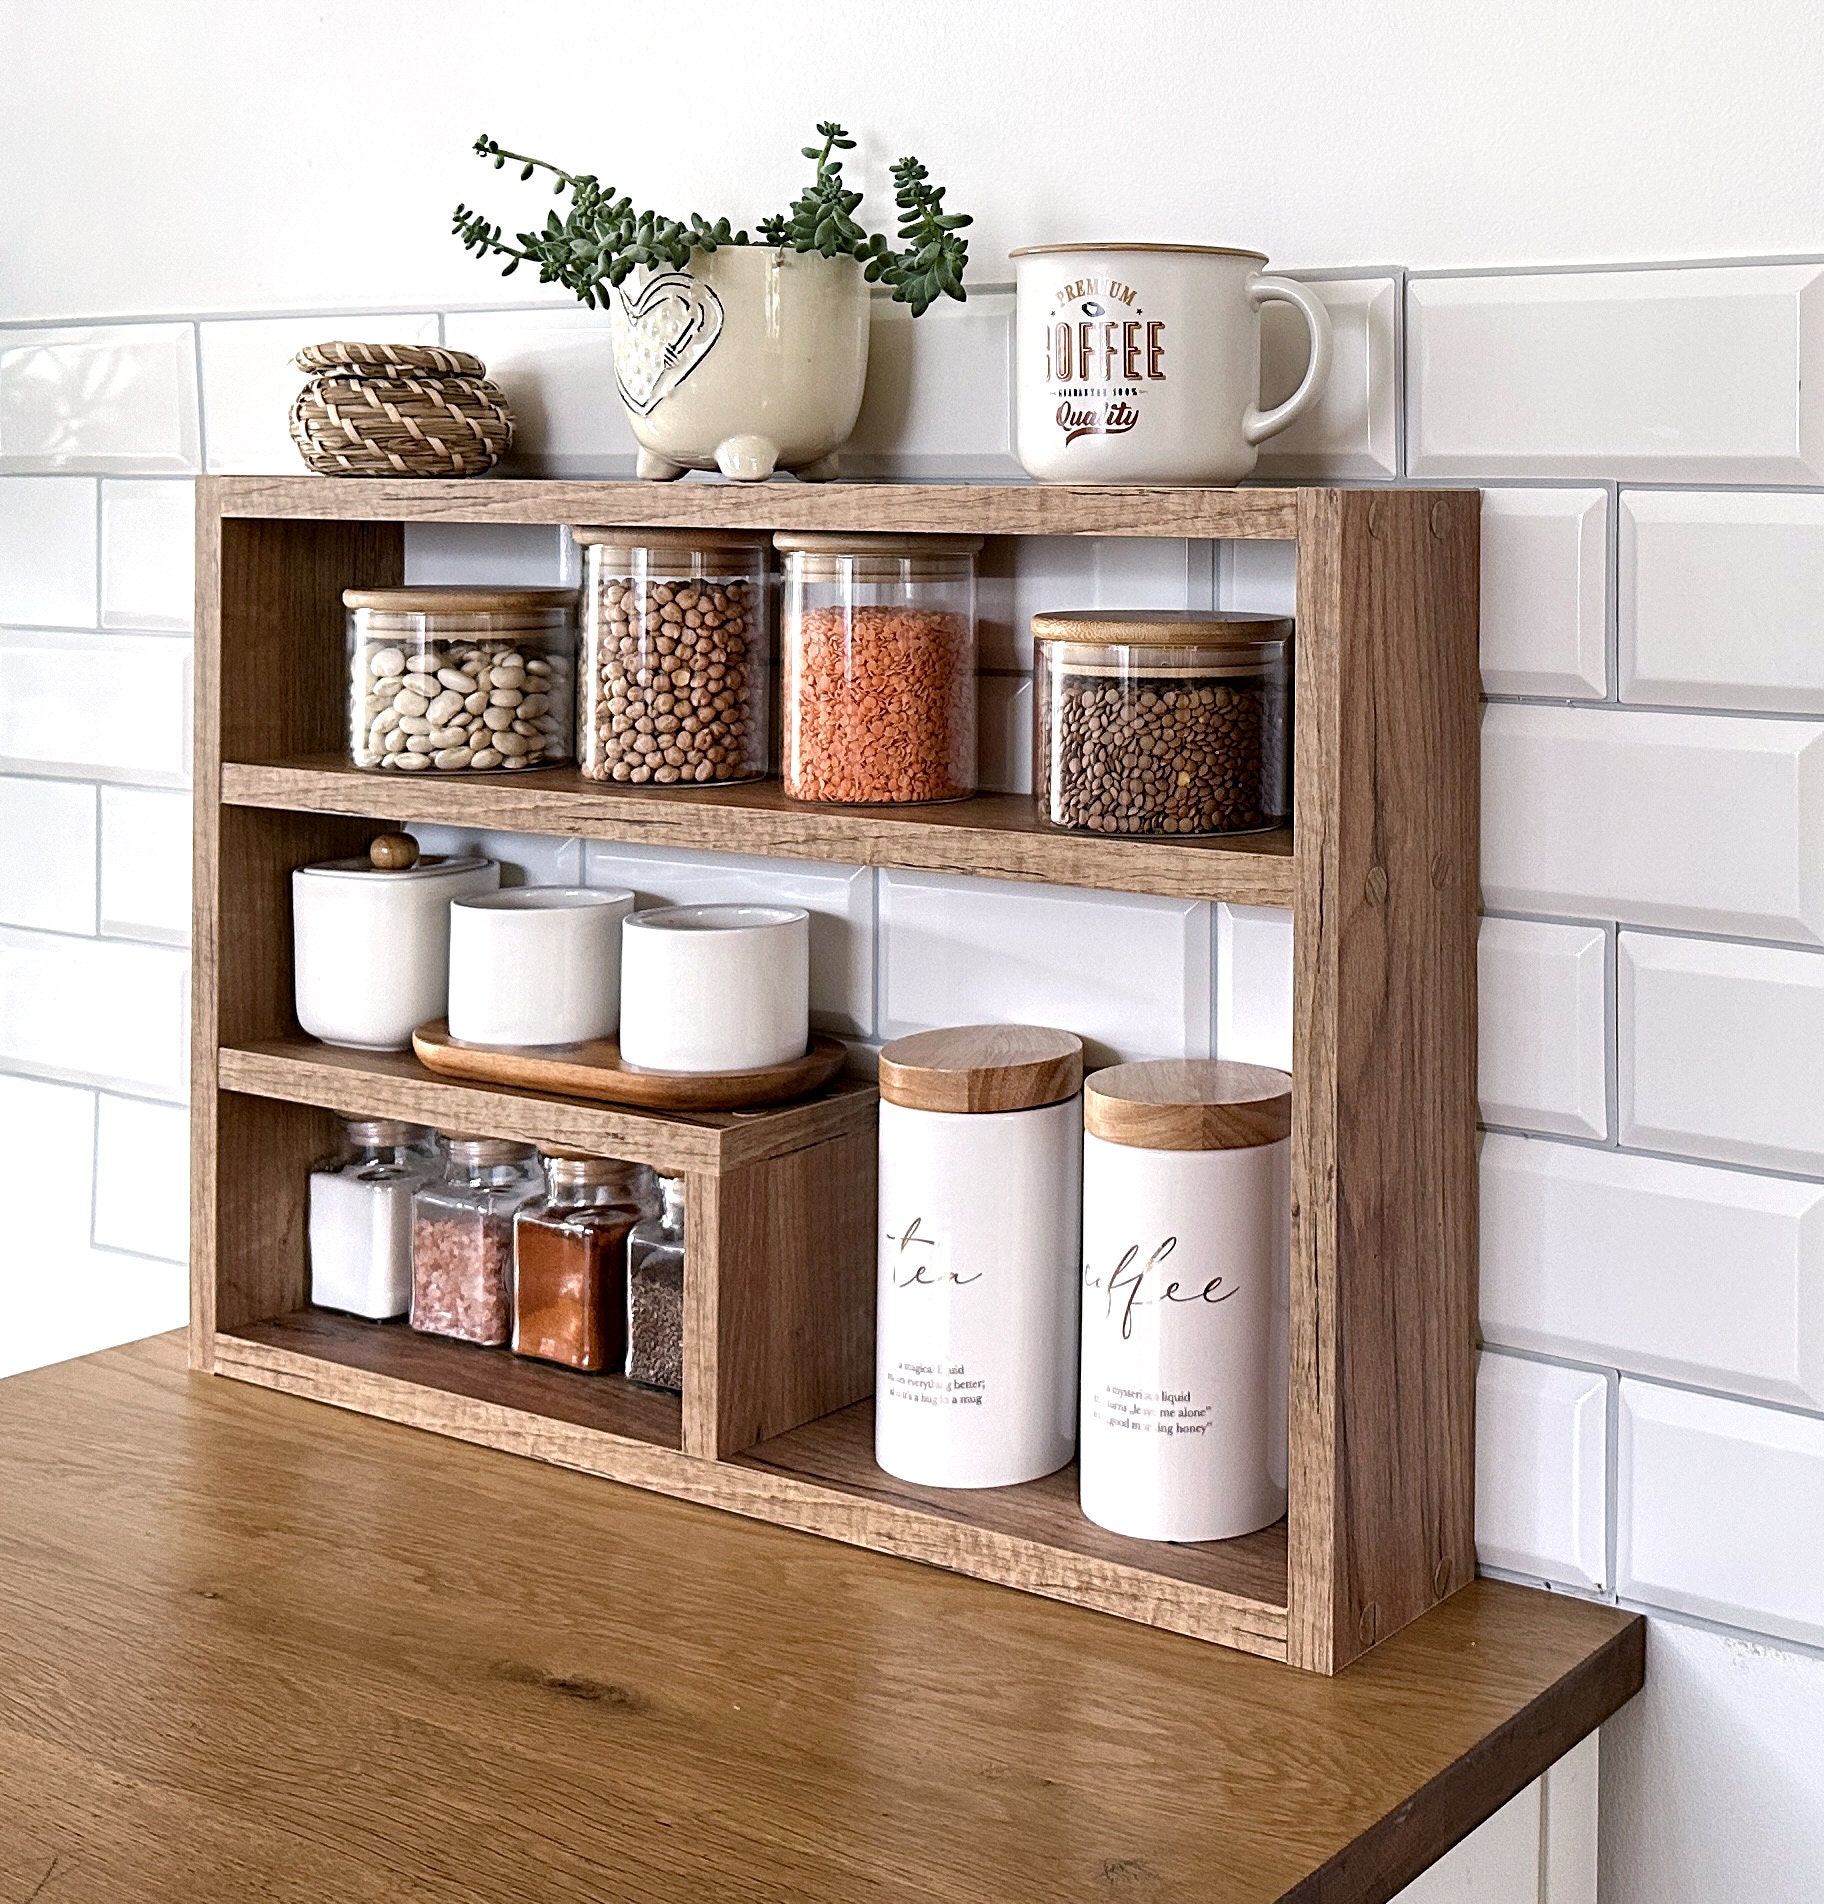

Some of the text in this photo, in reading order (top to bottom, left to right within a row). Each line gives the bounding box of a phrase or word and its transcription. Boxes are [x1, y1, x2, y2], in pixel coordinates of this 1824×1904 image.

[1056, 400, 1139, 447] Quality
[1161, 1390, 1191, 1405] liquid
[1160, 1409, 1175, 1417] me
